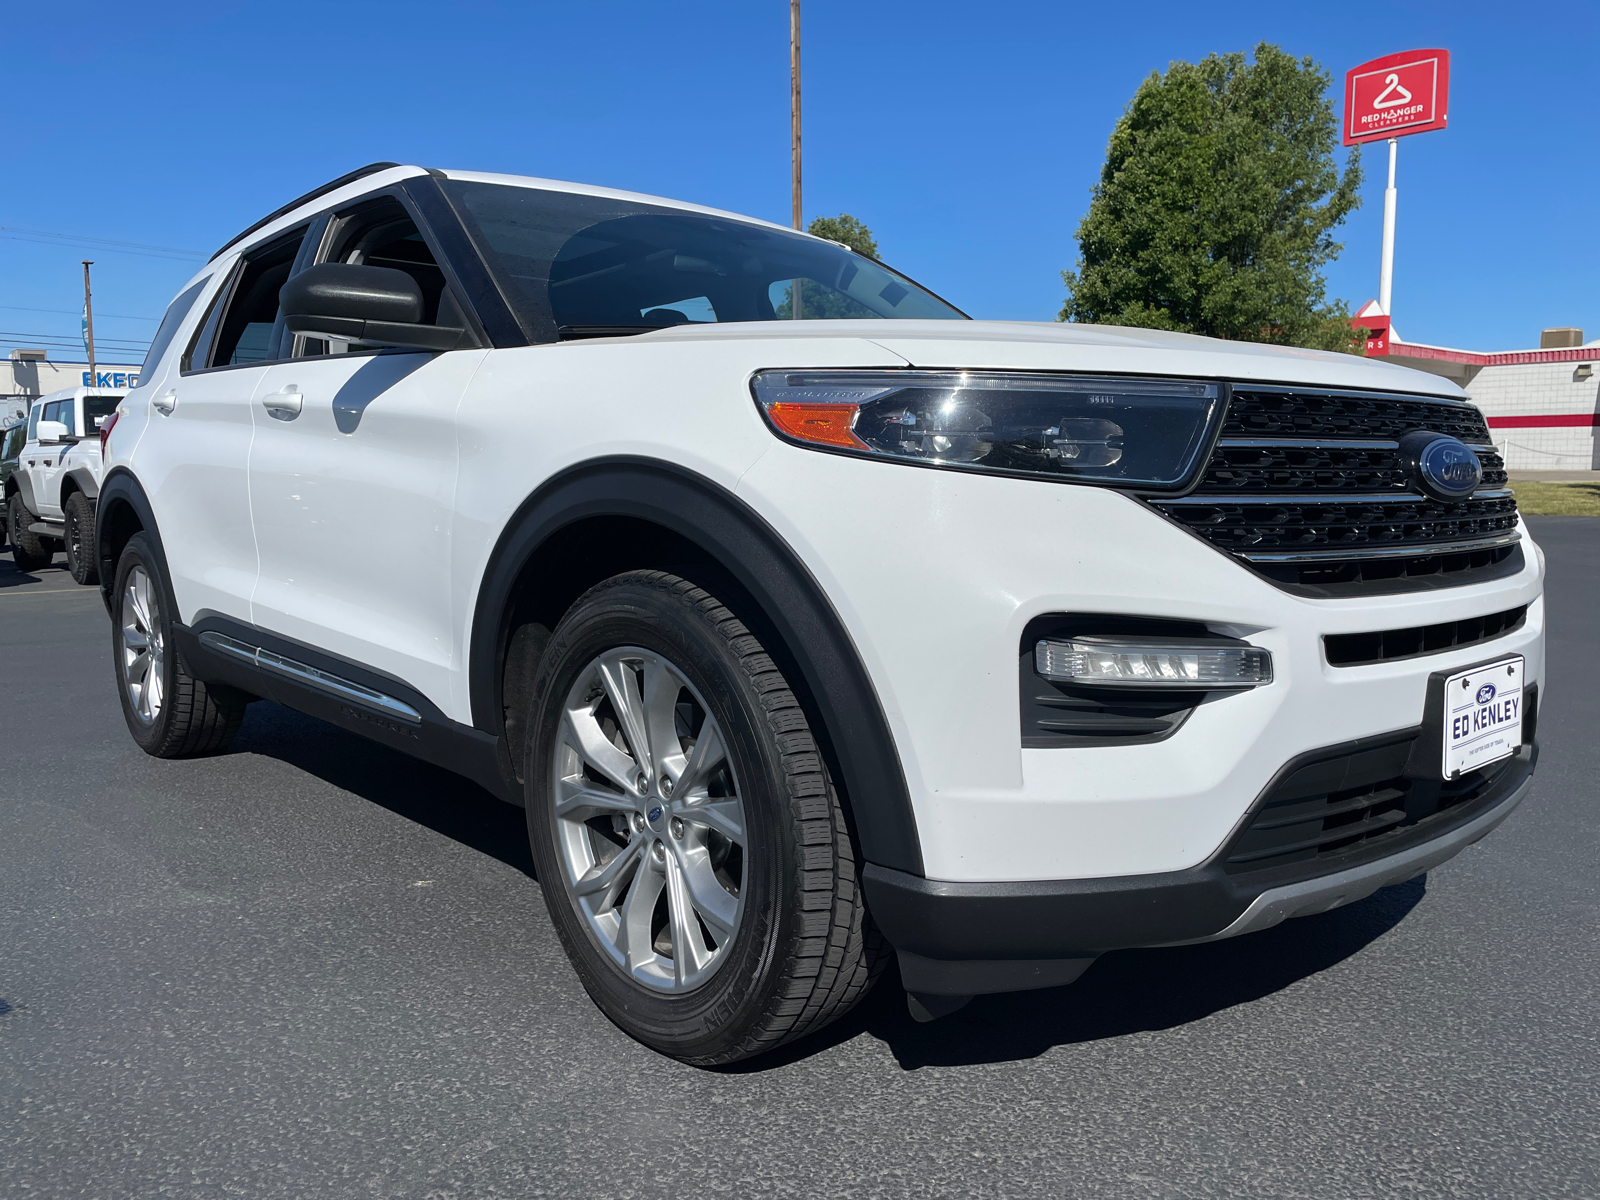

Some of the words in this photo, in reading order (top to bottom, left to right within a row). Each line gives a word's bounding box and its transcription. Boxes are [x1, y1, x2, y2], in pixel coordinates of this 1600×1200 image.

[1361, 112, 1380, 124] RED
[1381, 104, 1424, 120] HANGER
[1368, 115, 1415, 128] CLEANERS
[1441, 449, 1475, 481] Ford
[1478, 686, 1494, 703] Ford
[1453, 714, 1469, 740] ED
[1473, 697, 1520, 733] KENLEY
